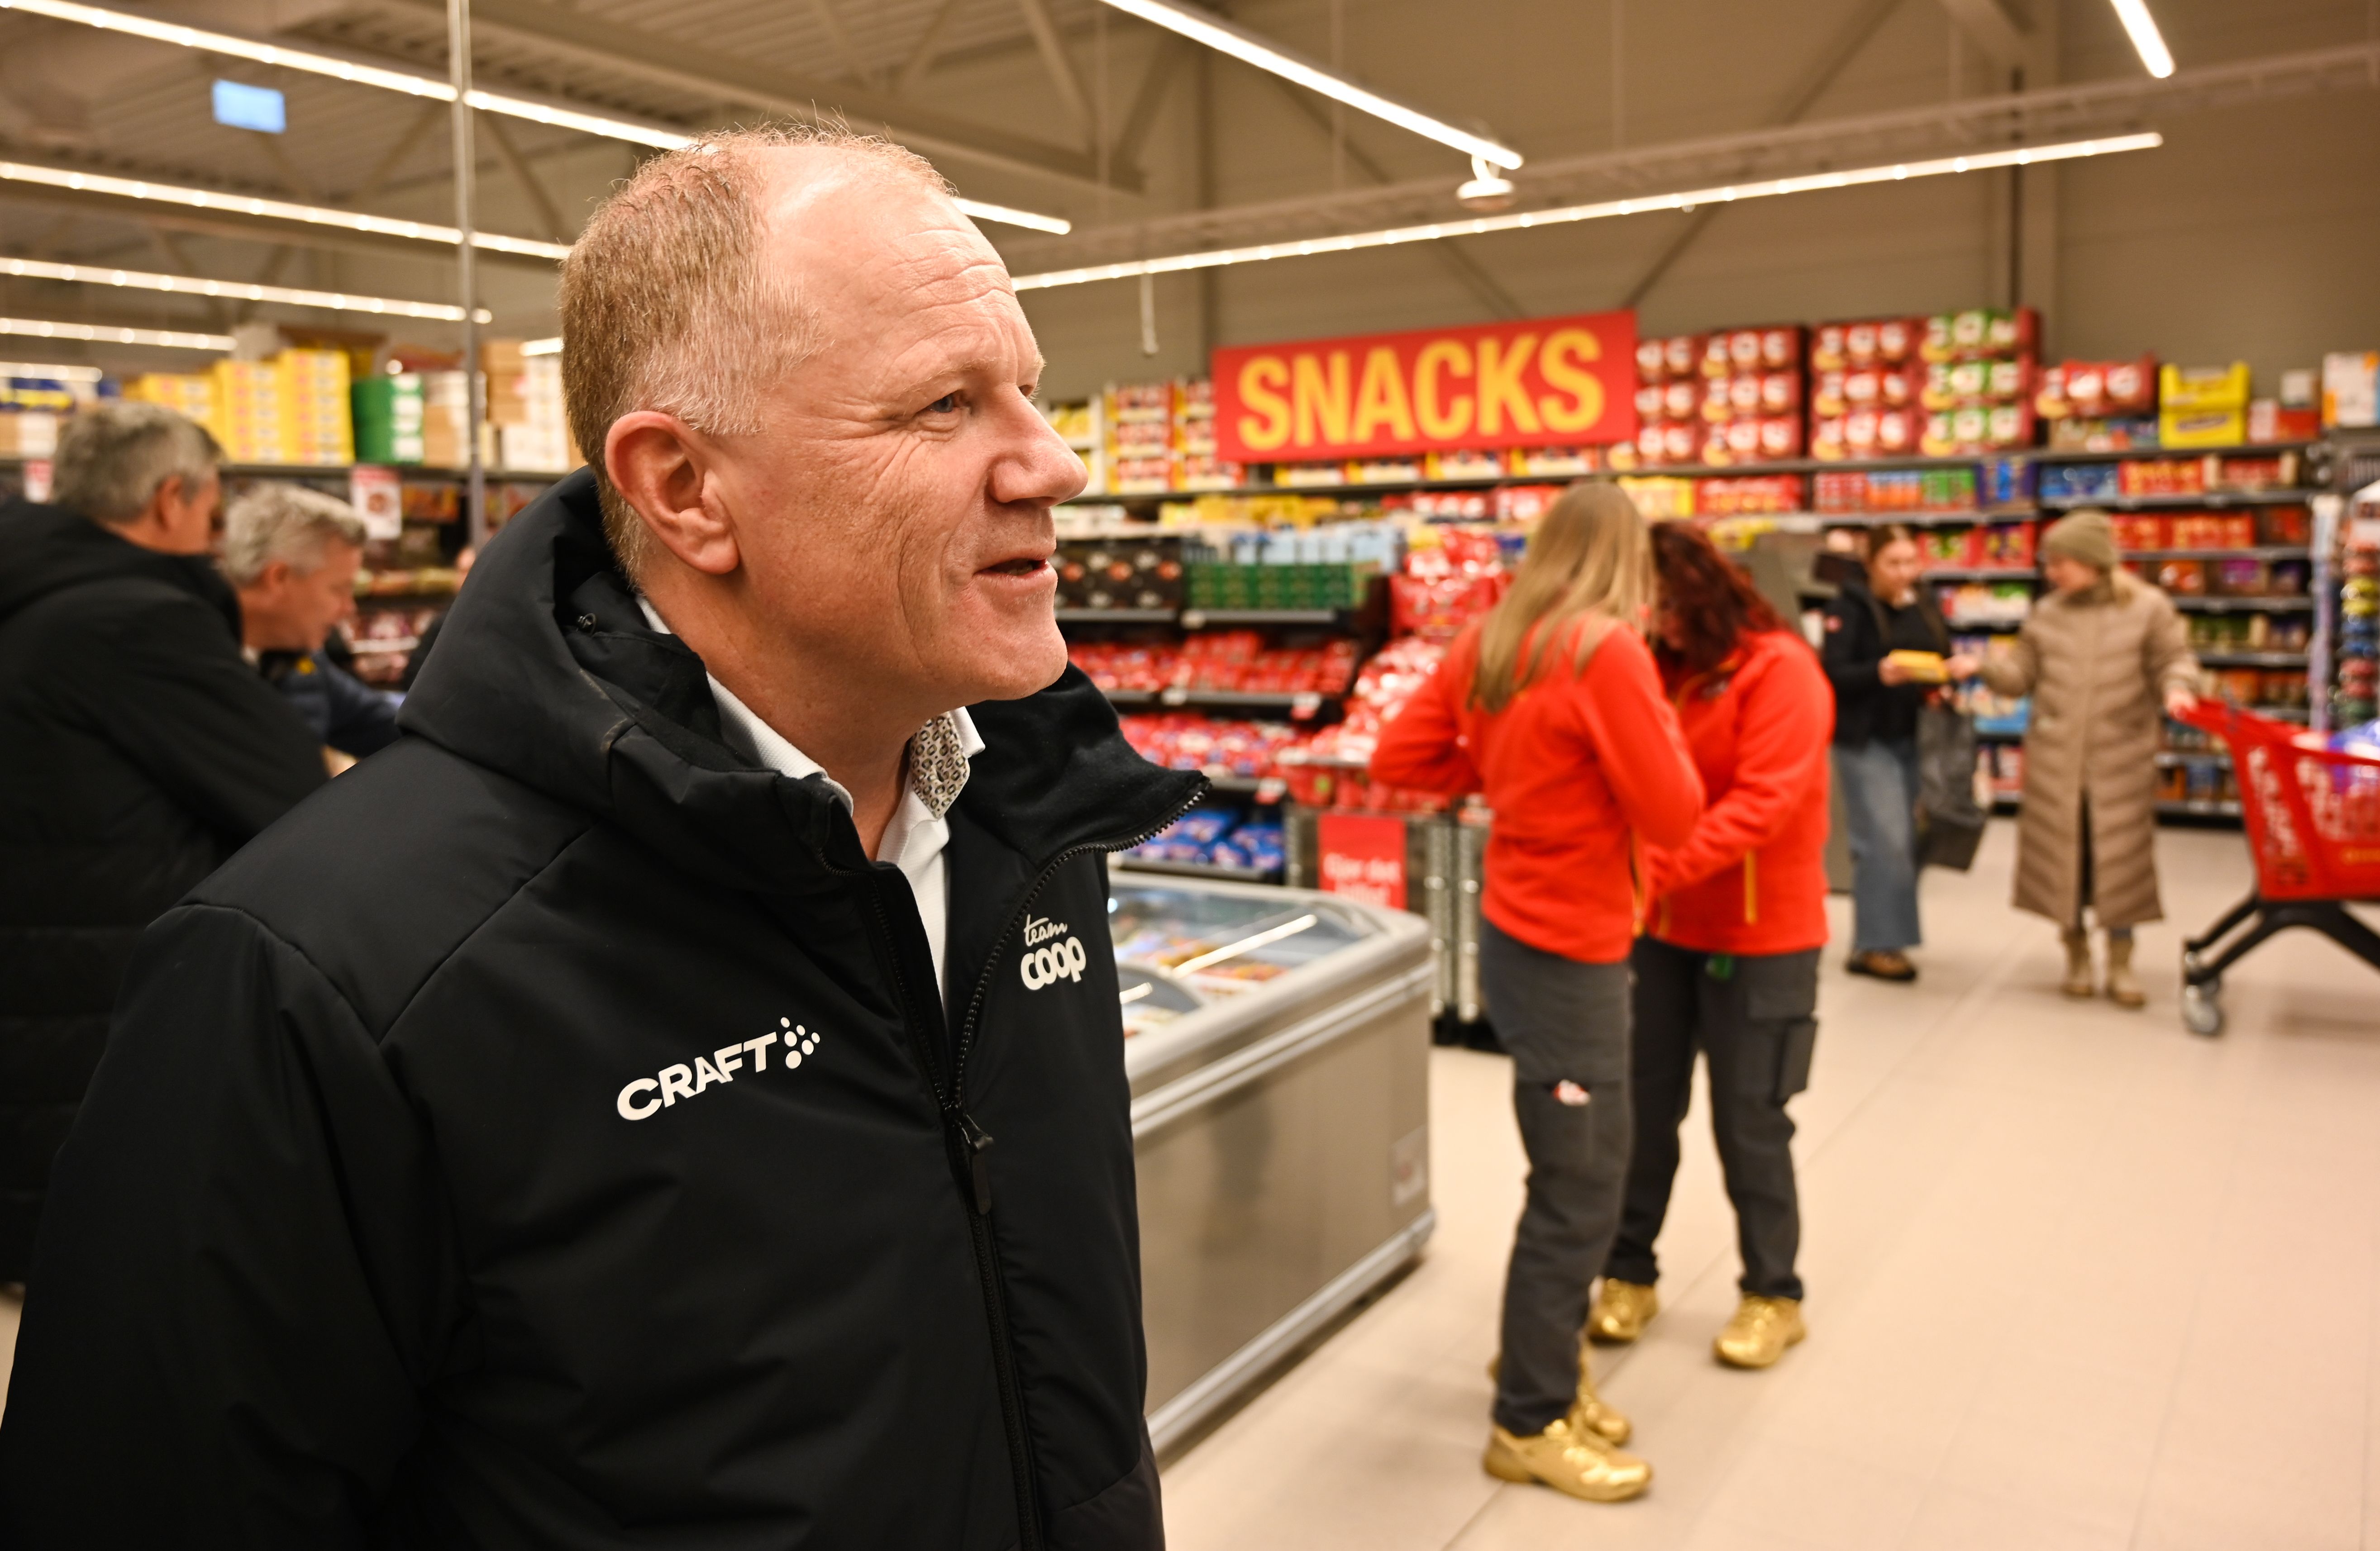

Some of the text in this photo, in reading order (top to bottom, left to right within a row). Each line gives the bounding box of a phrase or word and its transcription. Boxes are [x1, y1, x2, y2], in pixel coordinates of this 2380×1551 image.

[1237, 328, 1605, 452] SNACKS
[1021, 936, 1086, 990] coop
[1024, 914, 1068, 947] team
[617, 1032, 777, 1121] CRAFT
